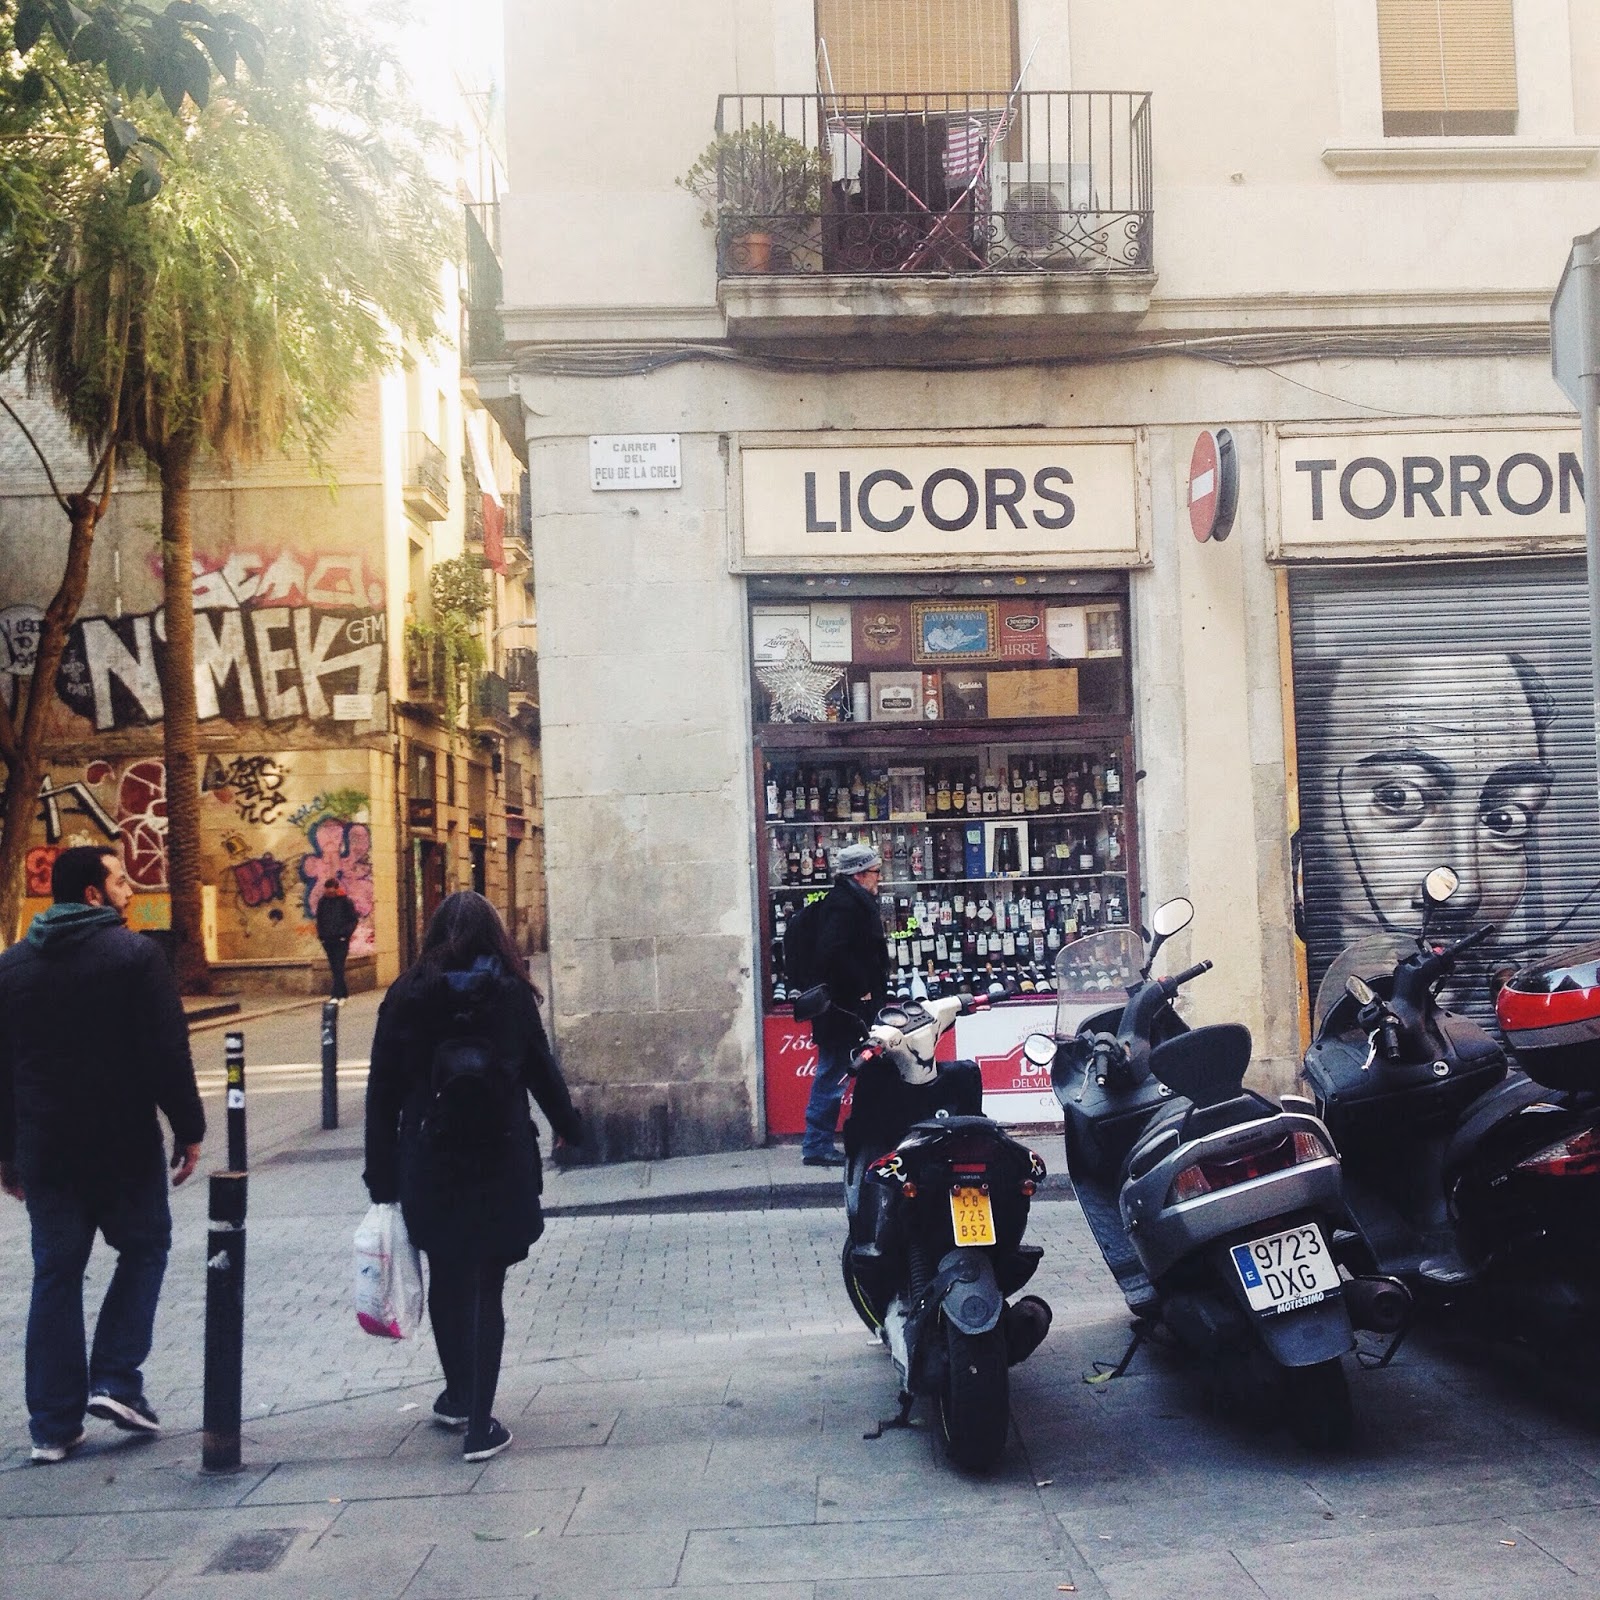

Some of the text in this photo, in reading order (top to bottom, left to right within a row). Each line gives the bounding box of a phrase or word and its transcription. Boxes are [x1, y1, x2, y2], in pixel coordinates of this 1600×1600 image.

[613, 443, 657, 452] CARRER
[624, 454, 646, 463] DEL
[595, 465, 677, 479] PEU DE LA CREU
[804, 466, 1076, 533] LICORS
[346, 613, 386, 644] GFM
[1012, 1079, 1032, 1088] DEL
[960, 1210, 985, 1222] 725
[1255, 1230, 1320, 1269] 9723
[1246, 1271, 1255, 1281] E
[1265, 1264, 1317, 1300] DXG
[1277, 1292, 1325, 1314] MOTISSIMO
